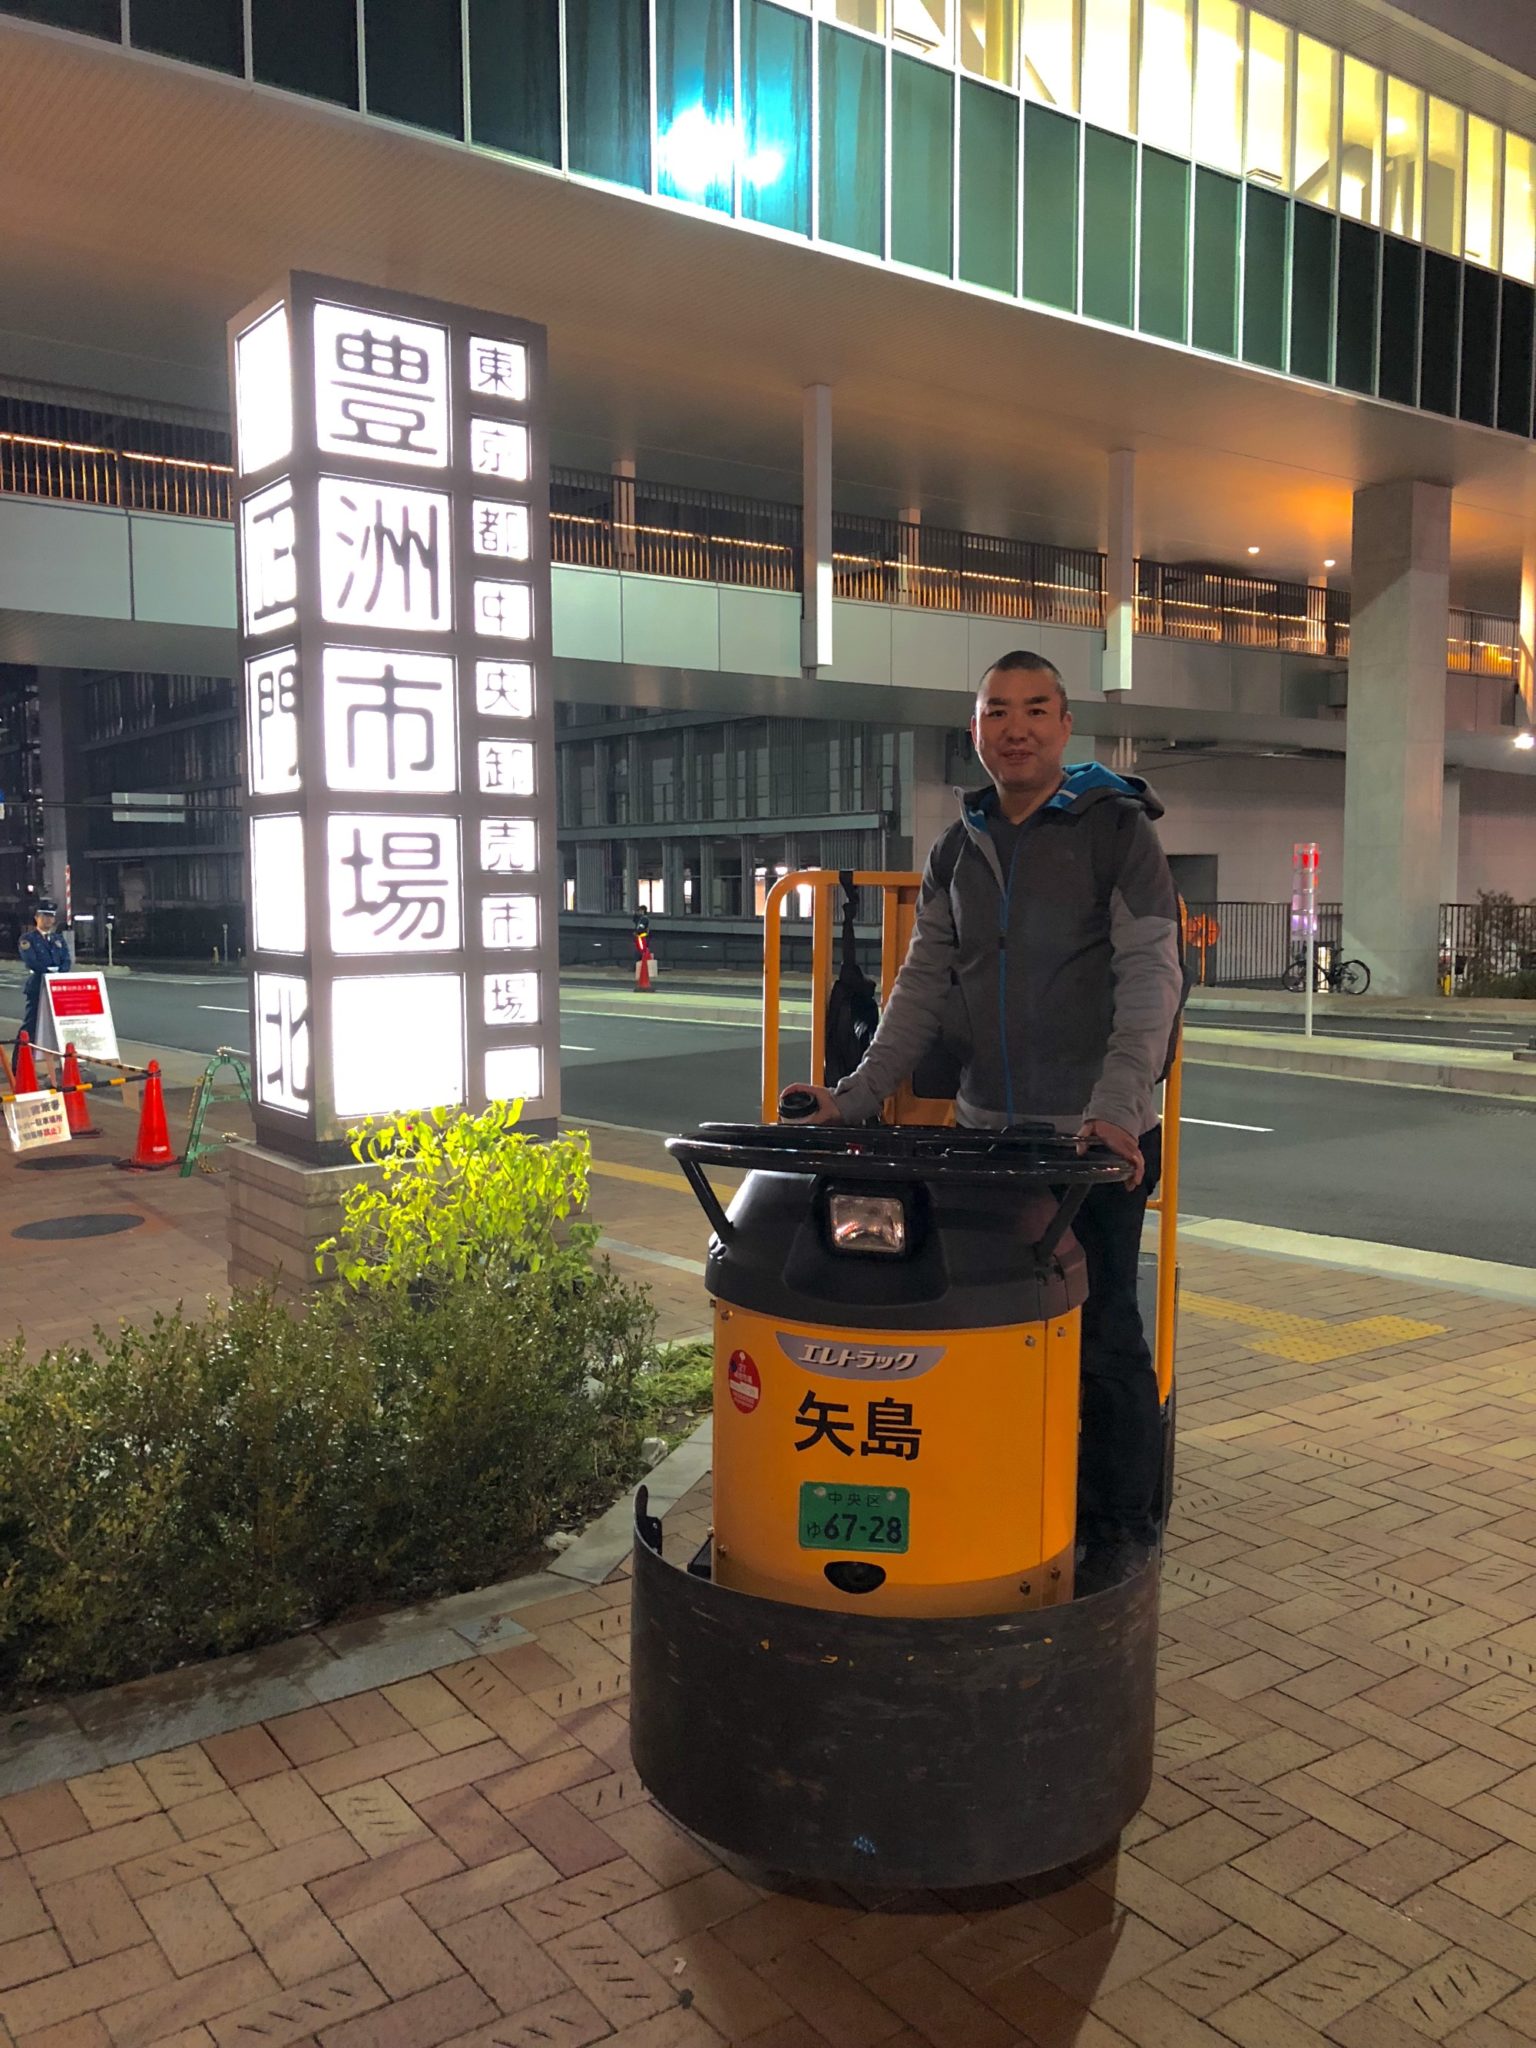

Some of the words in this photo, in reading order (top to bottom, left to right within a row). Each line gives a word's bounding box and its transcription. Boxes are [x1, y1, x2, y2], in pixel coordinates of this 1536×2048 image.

[330, 329, 449, 941] 豊洲市場
[477, 346, 526, 1020] 東京都中央卸売市場
[798, 1344, 918, 1371] エレトラック
[794, 1389, 922, 1461] 矢島
[828, 1491, 881, 1507] 中央区
[824, 1513, 902, 1544] 67-28
